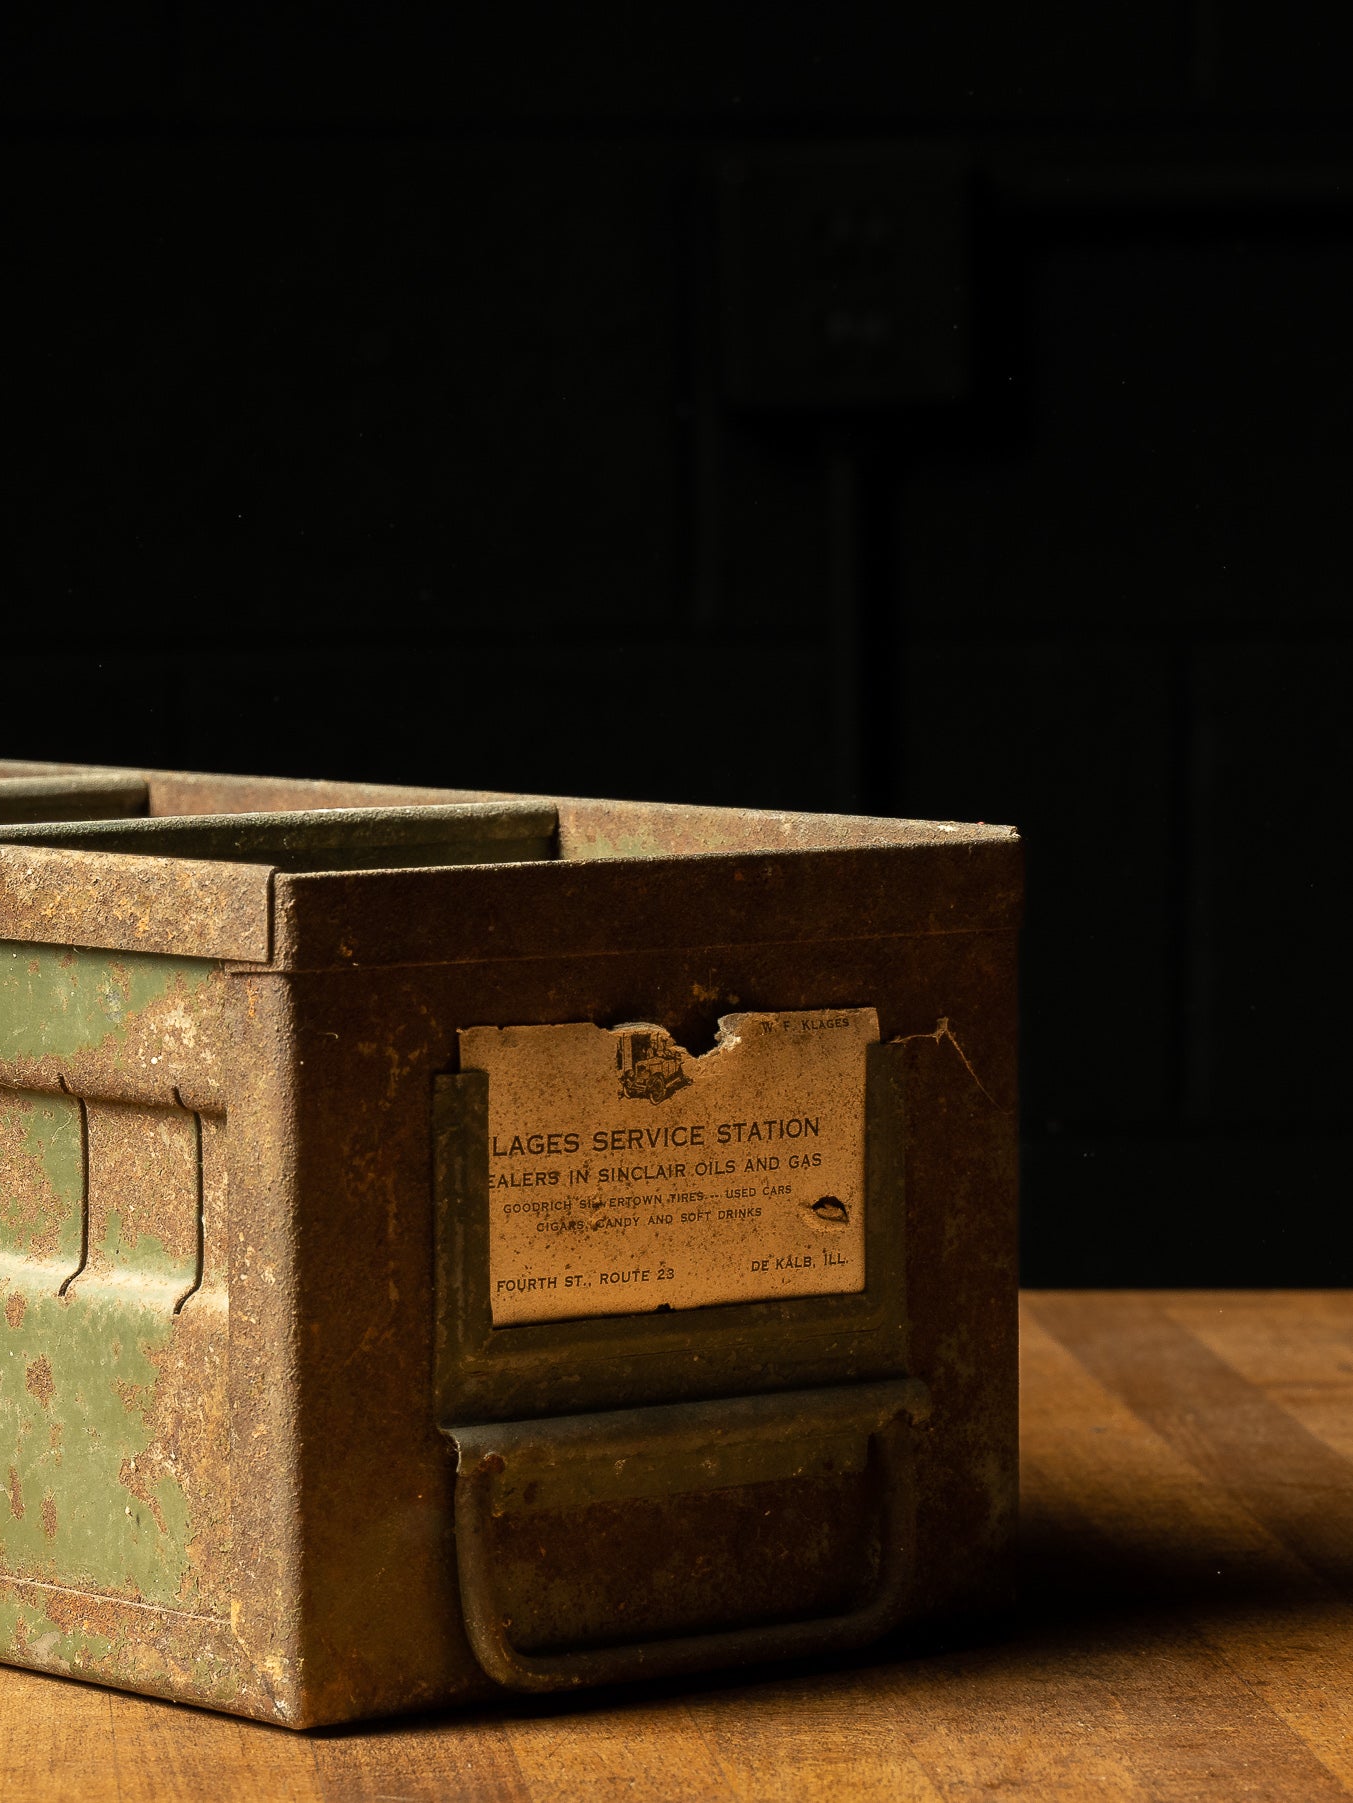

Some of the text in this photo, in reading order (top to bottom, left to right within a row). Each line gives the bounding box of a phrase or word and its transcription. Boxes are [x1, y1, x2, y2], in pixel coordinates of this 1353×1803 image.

[801, 1018, 850, 1030] KLAGES
[489, 1117, 820, 1156] LAGES SERVICE STATION
[488, 1153, 822, 1189] EALERS IN SINCLAIR OILS AND GAS
[503, 1200, 572, 1214] GOODRICH
[669, 1190, 704, 1203] TIRES
[725, 1187, 757, 1199] USED
[762, 1185, 792, 1196] CARS
[595, 1216, 640, 1229] CANDY
[648, 1214, 673, 1226] AND
[681, 1210, 711, 1223] SOFT
[717, 1207, 762, 1220] DRINKS
[751, 1252, 849, 1272] DE KALB, ILL.
[497, 1276, 558, 1292] FOURTH
[599, 1270, 650, 1285] ROUTE
[657, 1268, 674, 1281] 23
